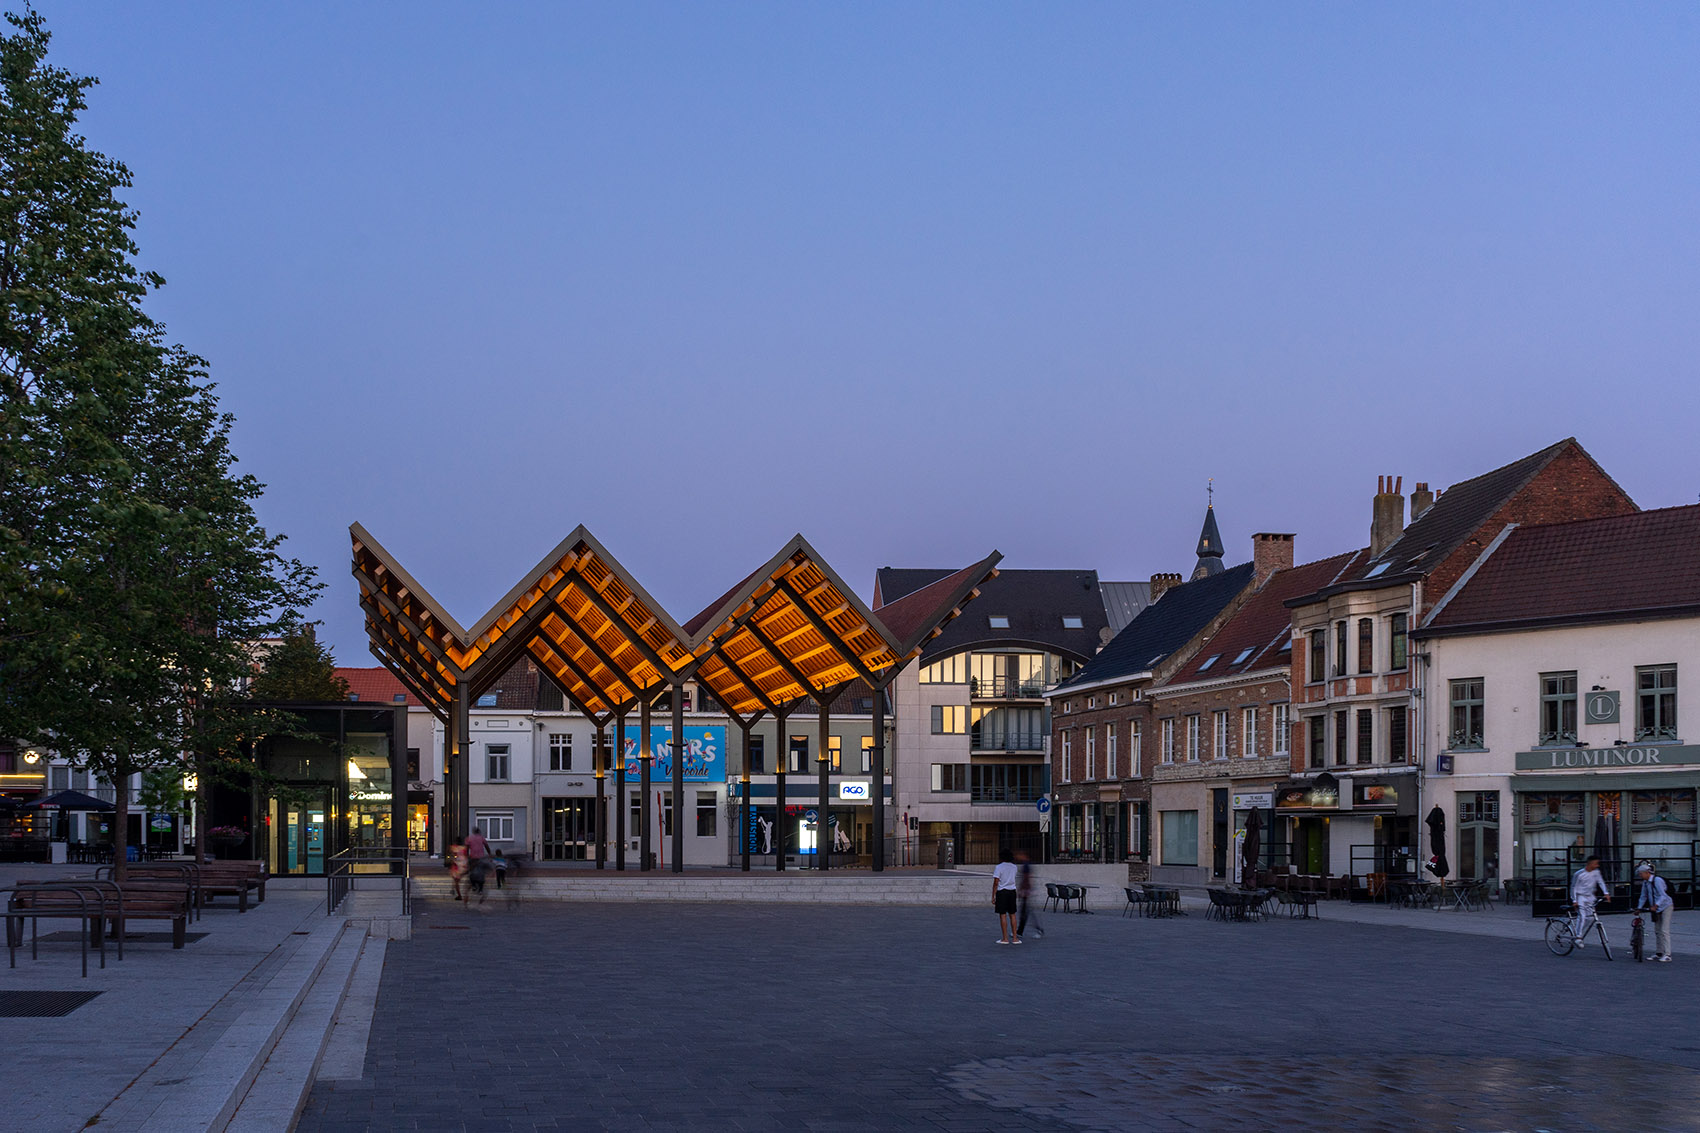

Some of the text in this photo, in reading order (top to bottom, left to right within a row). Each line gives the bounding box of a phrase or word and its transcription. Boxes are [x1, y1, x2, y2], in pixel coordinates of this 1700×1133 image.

[1596, 698, 1611, 715] L
[1551, 748, 1662, 767] LUMINOR
[665, 762, 709, 777] Voorde
[842, 786, 864, 795] AGO
